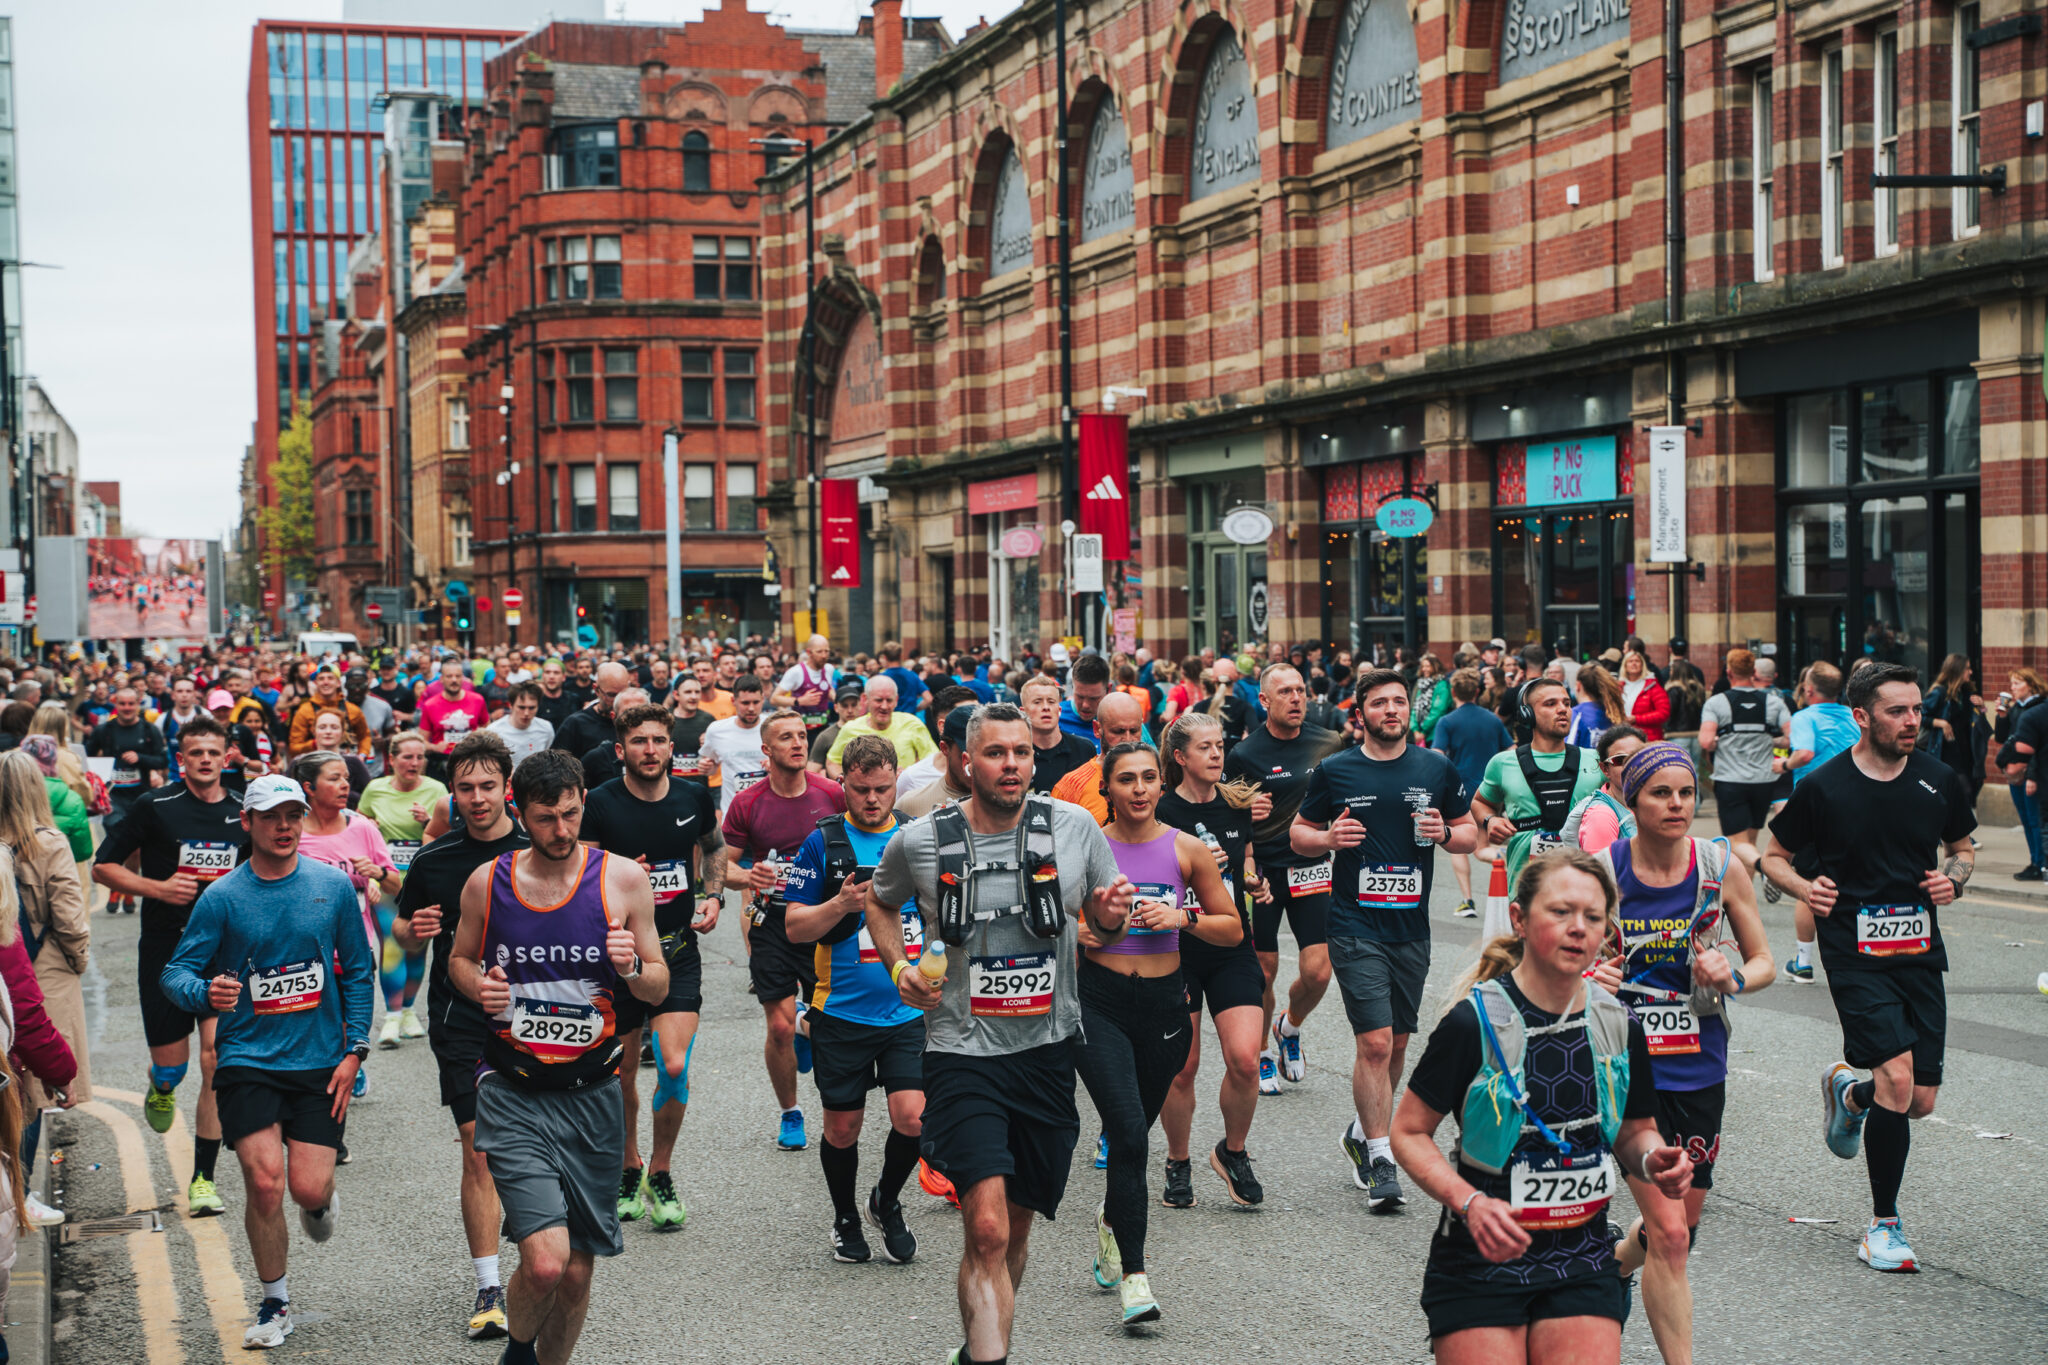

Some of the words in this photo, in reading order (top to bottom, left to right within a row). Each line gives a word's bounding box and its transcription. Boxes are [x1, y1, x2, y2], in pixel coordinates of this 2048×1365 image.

[1226, 96, 1245, 121] OF
[1553, 443, 1583, 472] PNG
[1553, 473, 1583, 499] PUCK
[1656, 467, 1670, 552] Management
[1389, 518, 1416, 528] PUCK
[1668, 517, 1680, 551] Suite
[185, 852, 231, 866] 25638
[1292, 867, 1330, 884] 26655
[1366, 876, 1416, 892] 23738
[1621, 919, 1646, 931] TH
[1866, 919, 1923, 938] 26720
[515, 945, 601, 963] sense
[259, 973, 318, 998] 24753
[979, 971, 1051, 995] 25992
[279, 996, 304, 1005] WESTON
[1008, 998, 1031, 1006] COWIE
[519, 1019, 593, 1044] 28925
[1648, 1036, 1664, 1044] LISA
[1523, 1171, 1608, 1202] 27264
[1549, 1205, 1585, 1217] REBECCA
